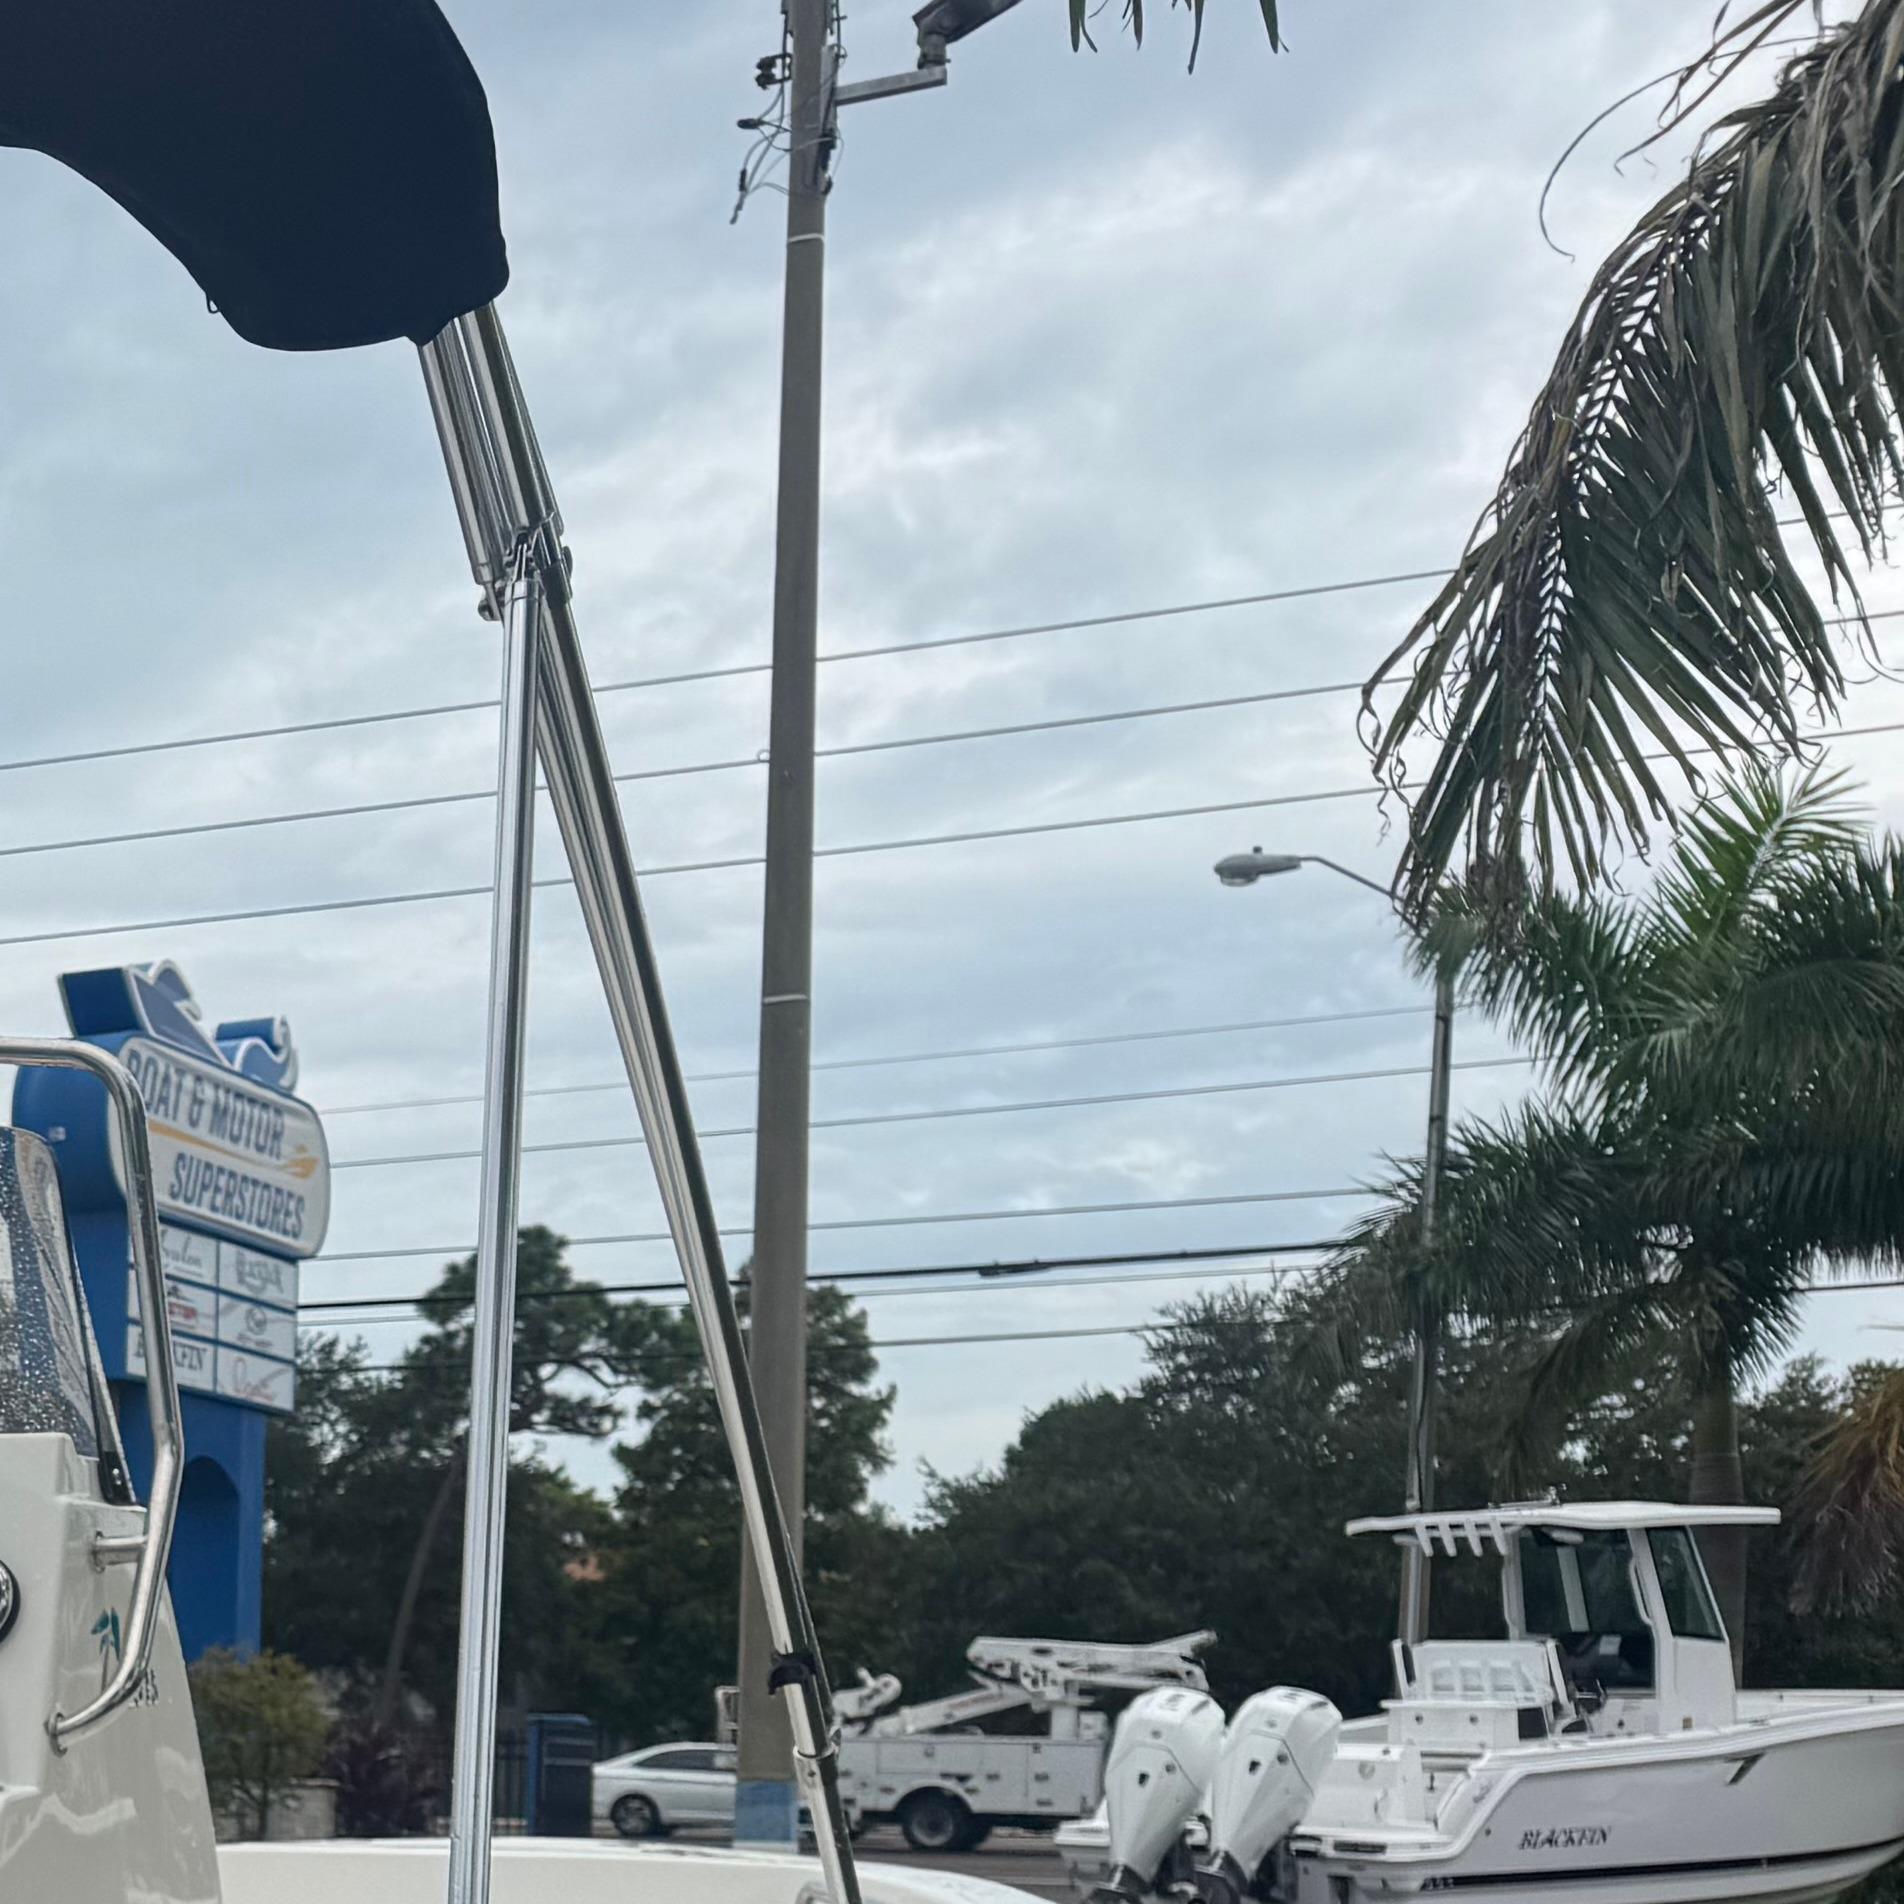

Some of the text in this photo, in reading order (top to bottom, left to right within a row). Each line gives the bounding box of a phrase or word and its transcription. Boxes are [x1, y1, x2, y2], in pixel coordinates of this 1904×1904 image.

[188, 1075, 207, 1129] &
[207, 1084, 285, 1161] MOTOR
[170, 1152, 306, 1239] SUPERSTORES
[1518, 1825, 1612, 1851] BLACKFIN
